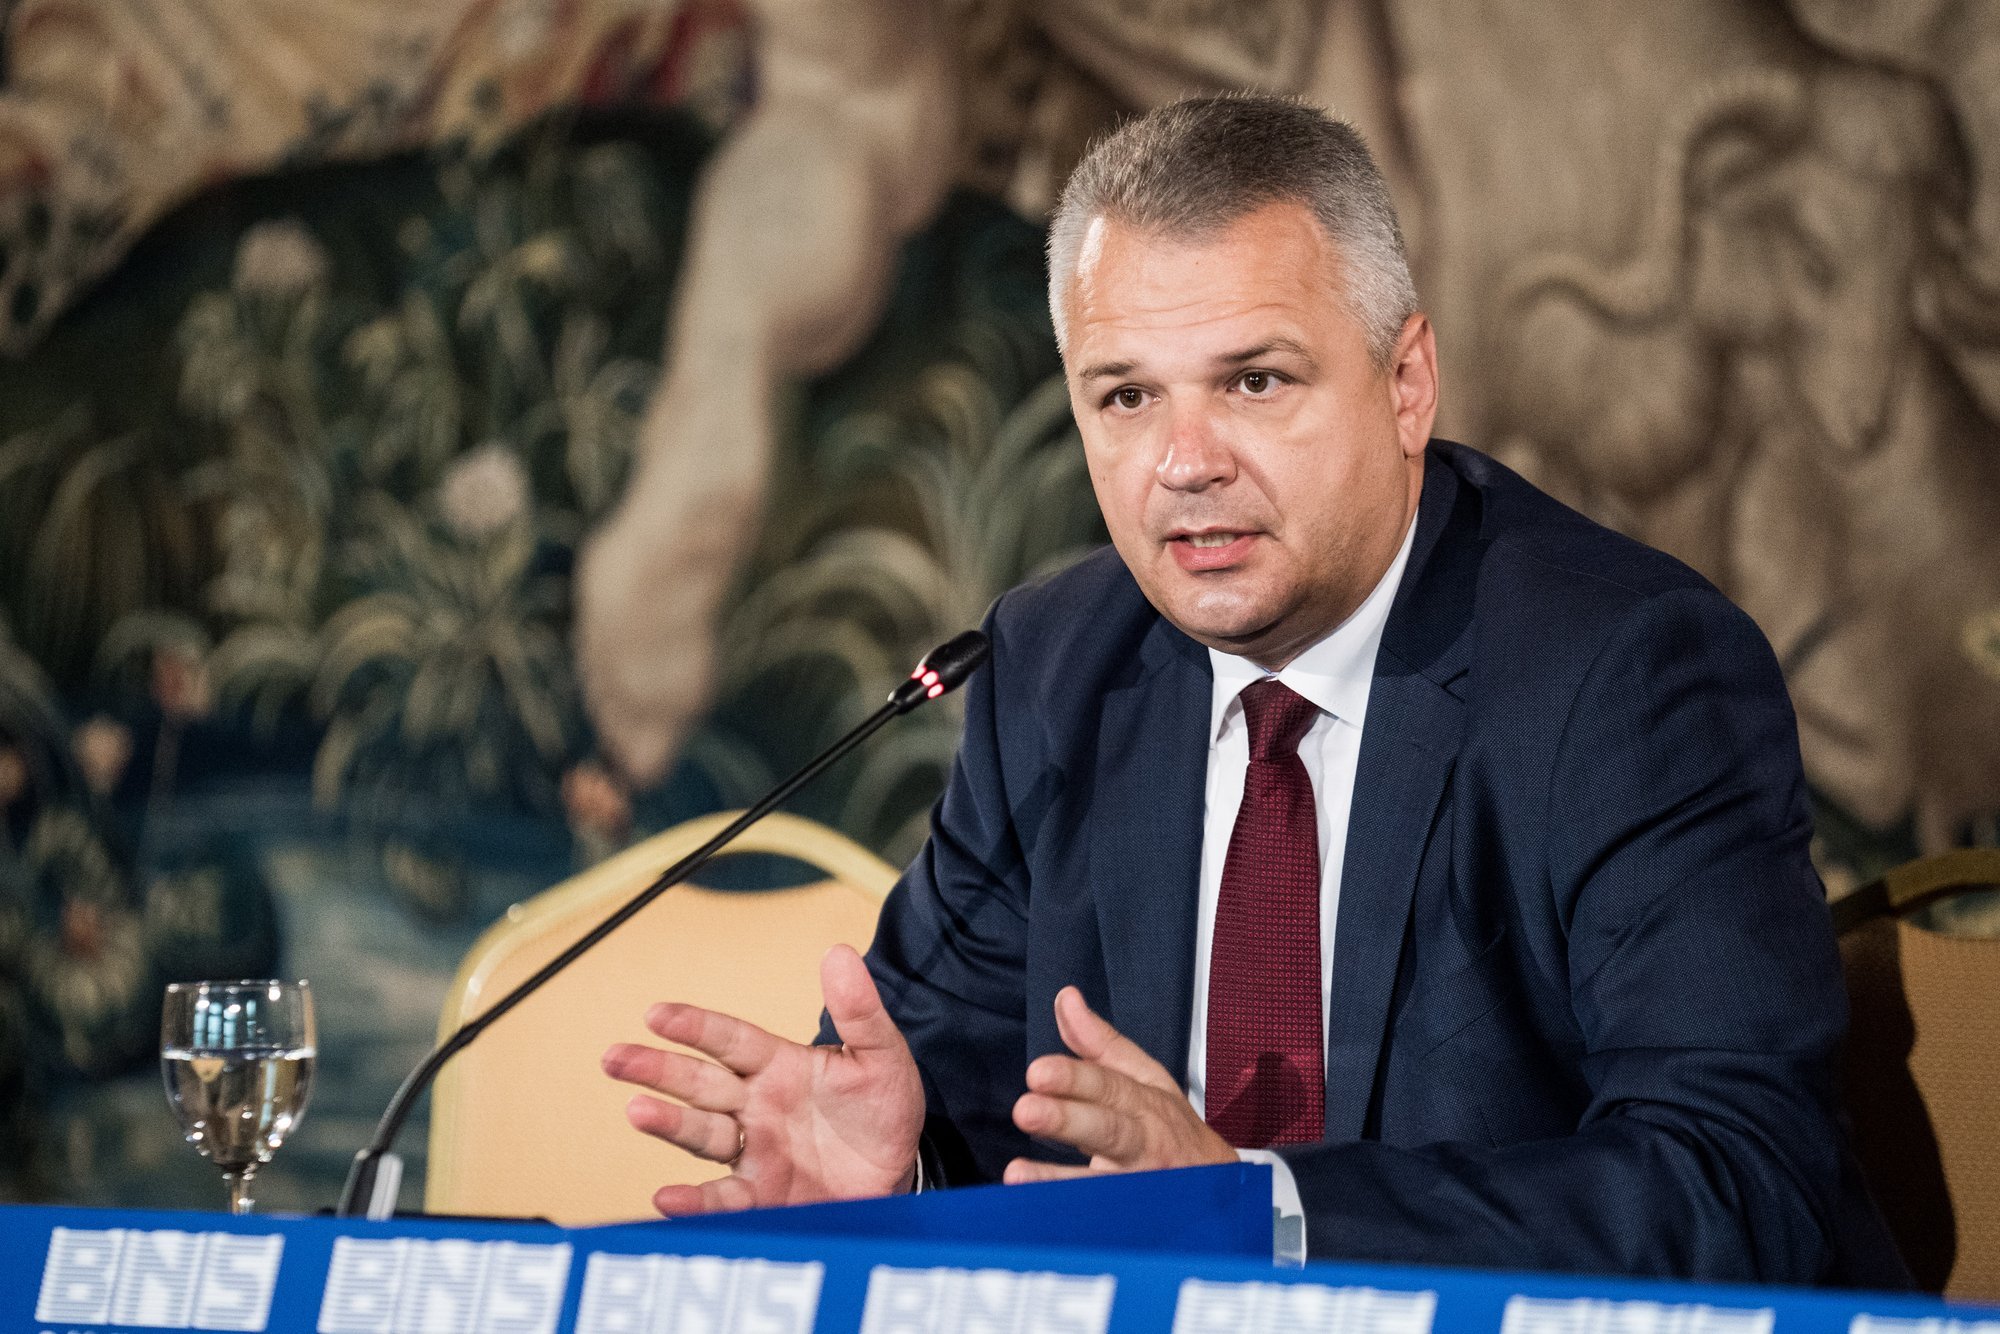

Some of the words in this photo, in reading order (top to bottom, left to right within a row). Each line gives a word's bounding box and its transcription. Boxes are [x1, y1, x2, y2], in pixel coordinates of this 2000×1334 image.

[35, 1227, 285, 1332] BNS
[316, 1236, 573, 1334] BNS
[574, 1251, 825, 1334] BNS
